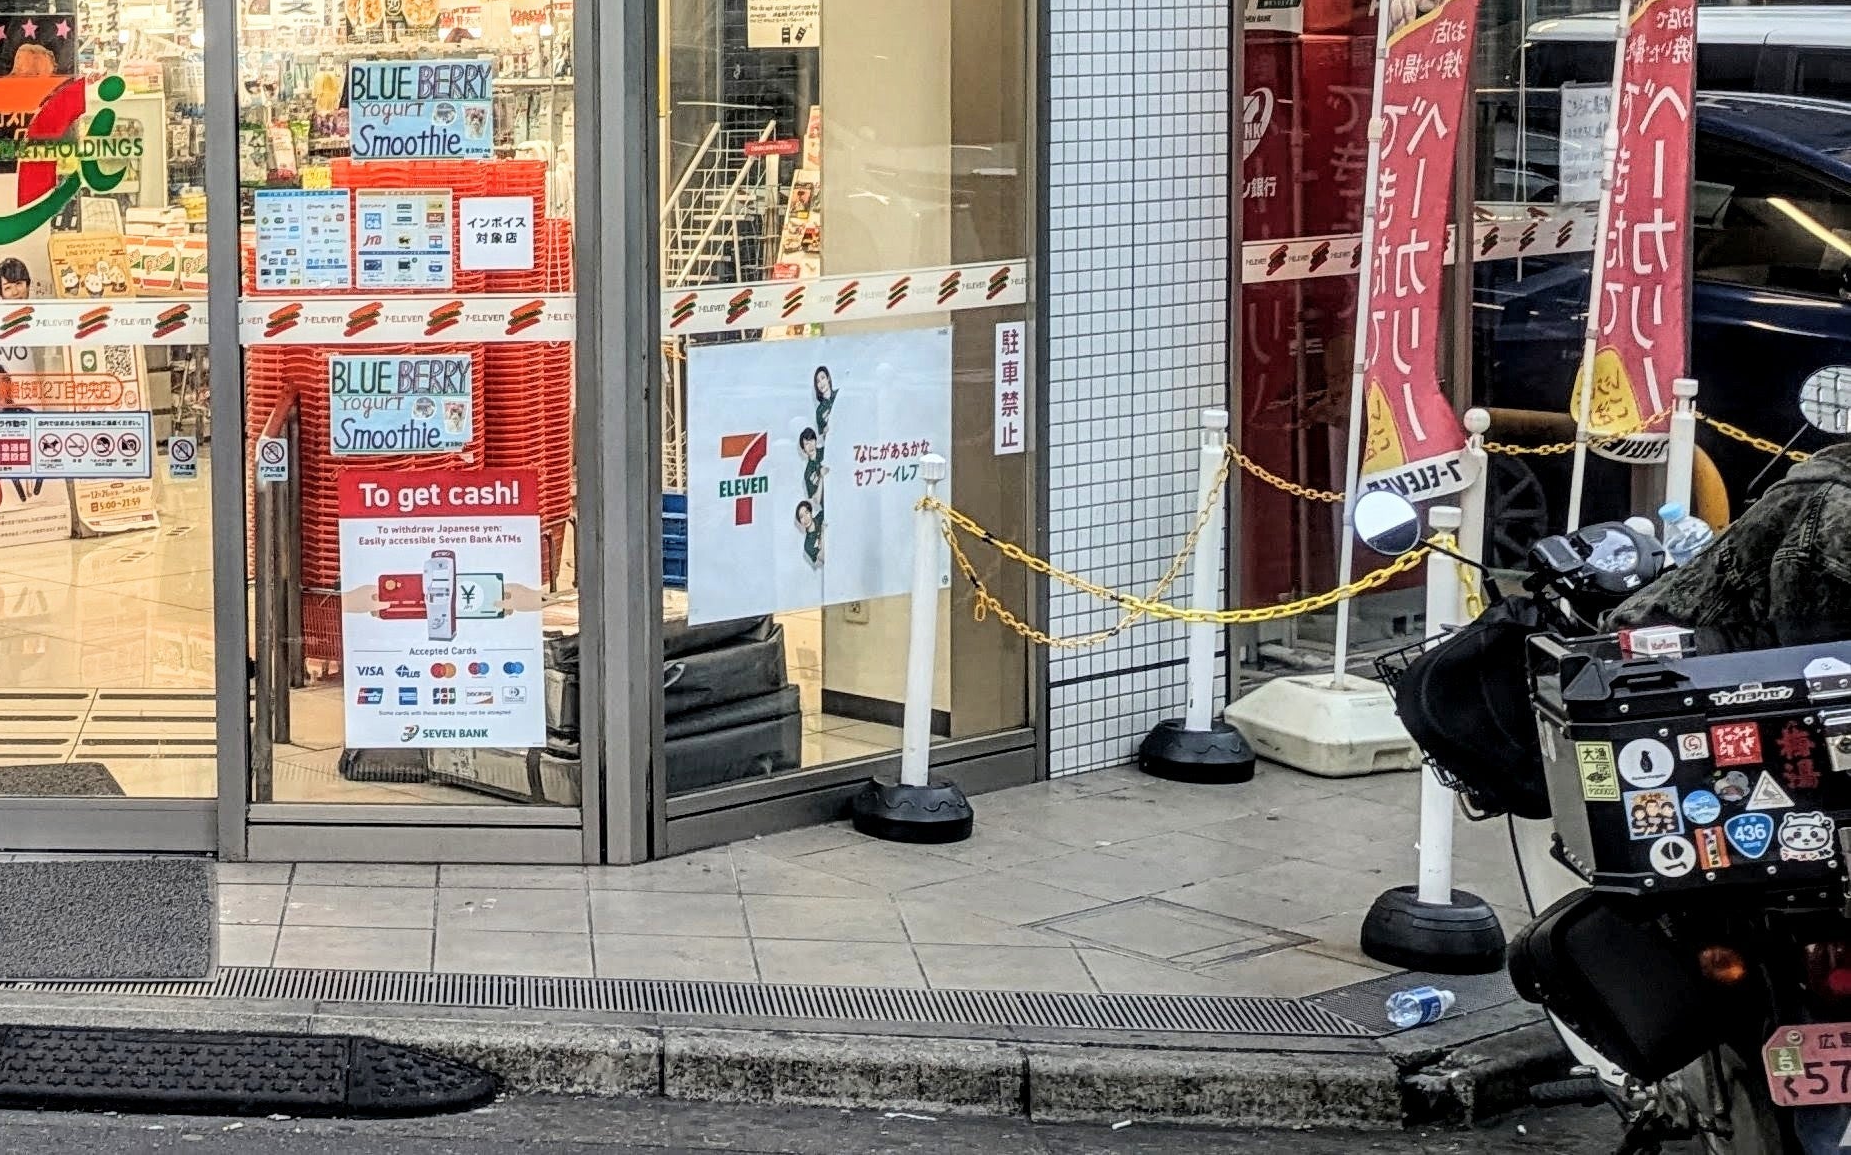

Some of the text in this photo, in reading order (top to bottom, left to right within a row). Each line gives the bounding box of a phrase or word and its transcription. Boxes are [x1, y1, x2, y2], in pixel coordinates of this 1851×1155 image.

[351, 64, 492, 100] BLUE BERRY
[45, 137, 144, 158] HOLDINGS
[352, 124, 462, 157] Smoothie
[467, 217, 527, 229] インボイス
[476, 232, 518, 245] 対象店
[332, 359, 471, 394] BLUE BERRY
[1000, 328, 1020, 449] 駐車禁止
[334, 418, 441, 450] Smoothie
[358, 480, 519, 512] To get cash!
[378, 525, 389, 534] To
[391, 525, 434, 533] withdraw
[437, 524, 480, 535] Japanese
[358, 535, 522, 547] Easily accessible Seven Bank ATMs
[409, 647, 477, 657] Accepted Cards
[356, 666, 385, 676] VISA
[422, 728, 489, 738] SEVEN BANK
[1734, 824, 1766, 842] 436
